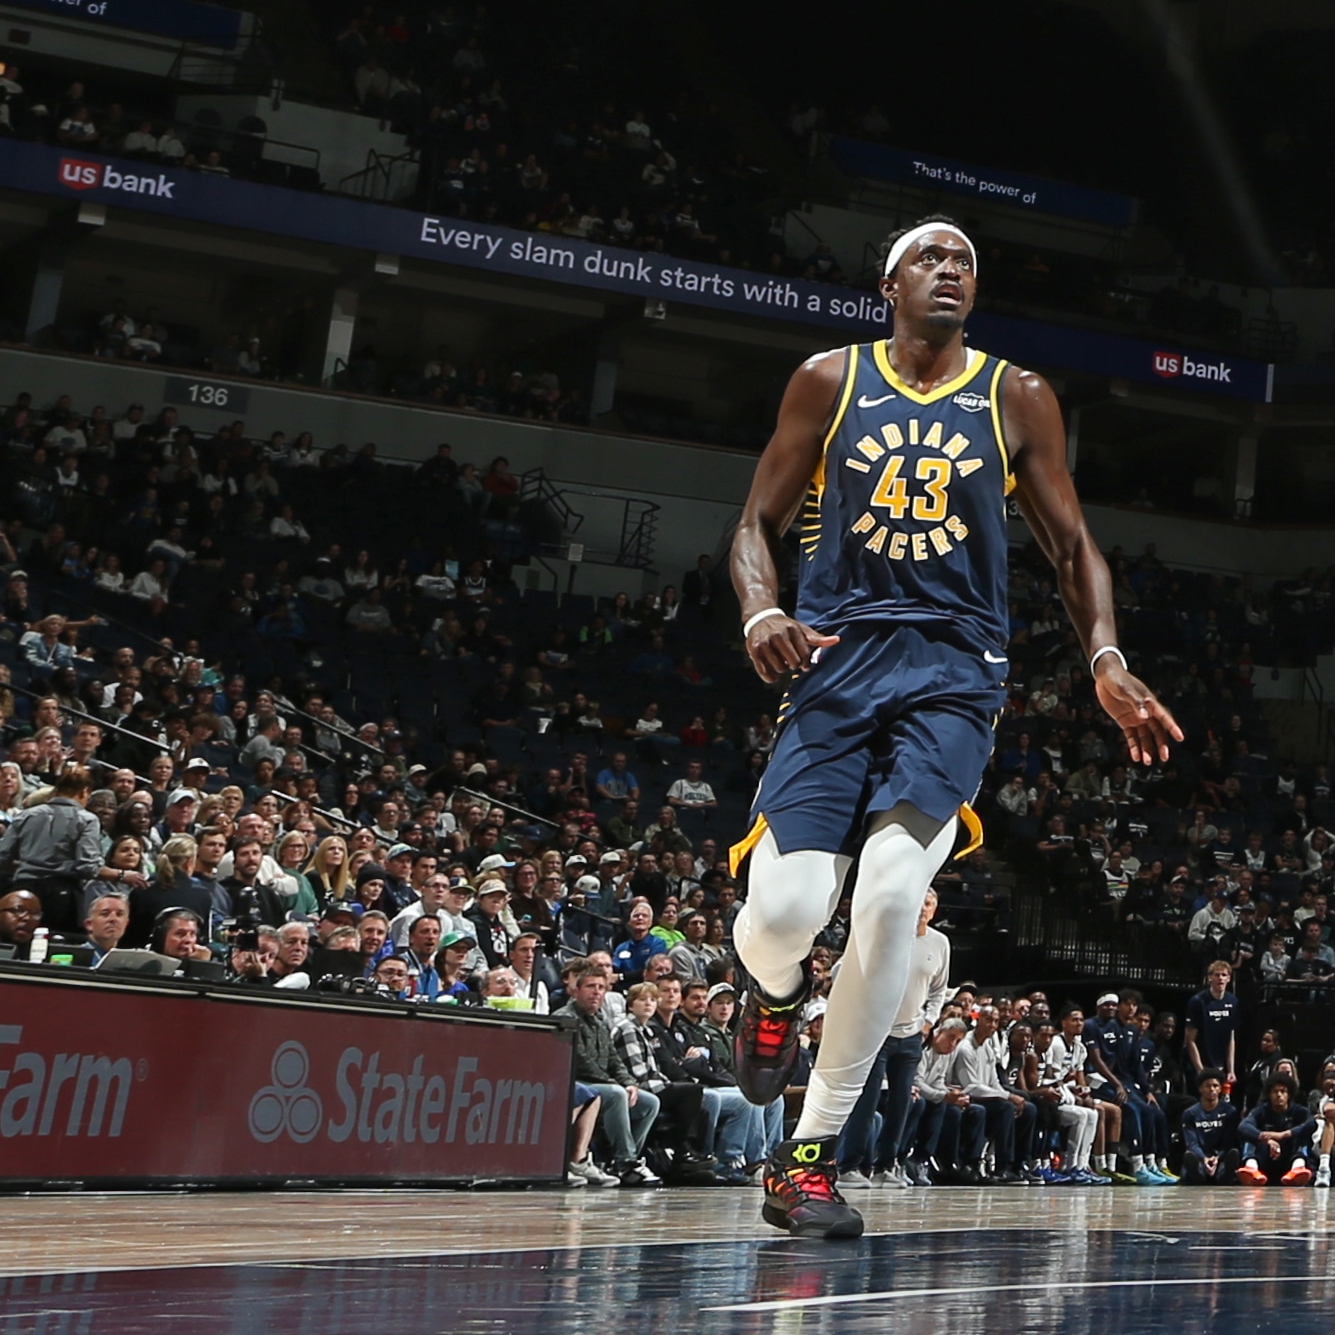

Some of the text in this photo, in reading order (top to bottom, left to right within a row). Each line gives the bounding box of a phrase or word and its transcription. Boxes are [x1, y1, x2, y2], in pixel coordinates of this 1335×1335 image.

[88, 2, 107, 15] of
[62, 164, 175, 198] us bank
[913, 161, 1037, 204] That's the power of
[420, 217, 888, 324] Every slam dunk starts with a solid
[1155, 356, 1231, 383] us bank
[188, 384, 228, 406] 136
[845, 418, 984, 478] INDIANA
[870, 455, 952, 522] 43
[851, 511, 969, 561] PACERS
